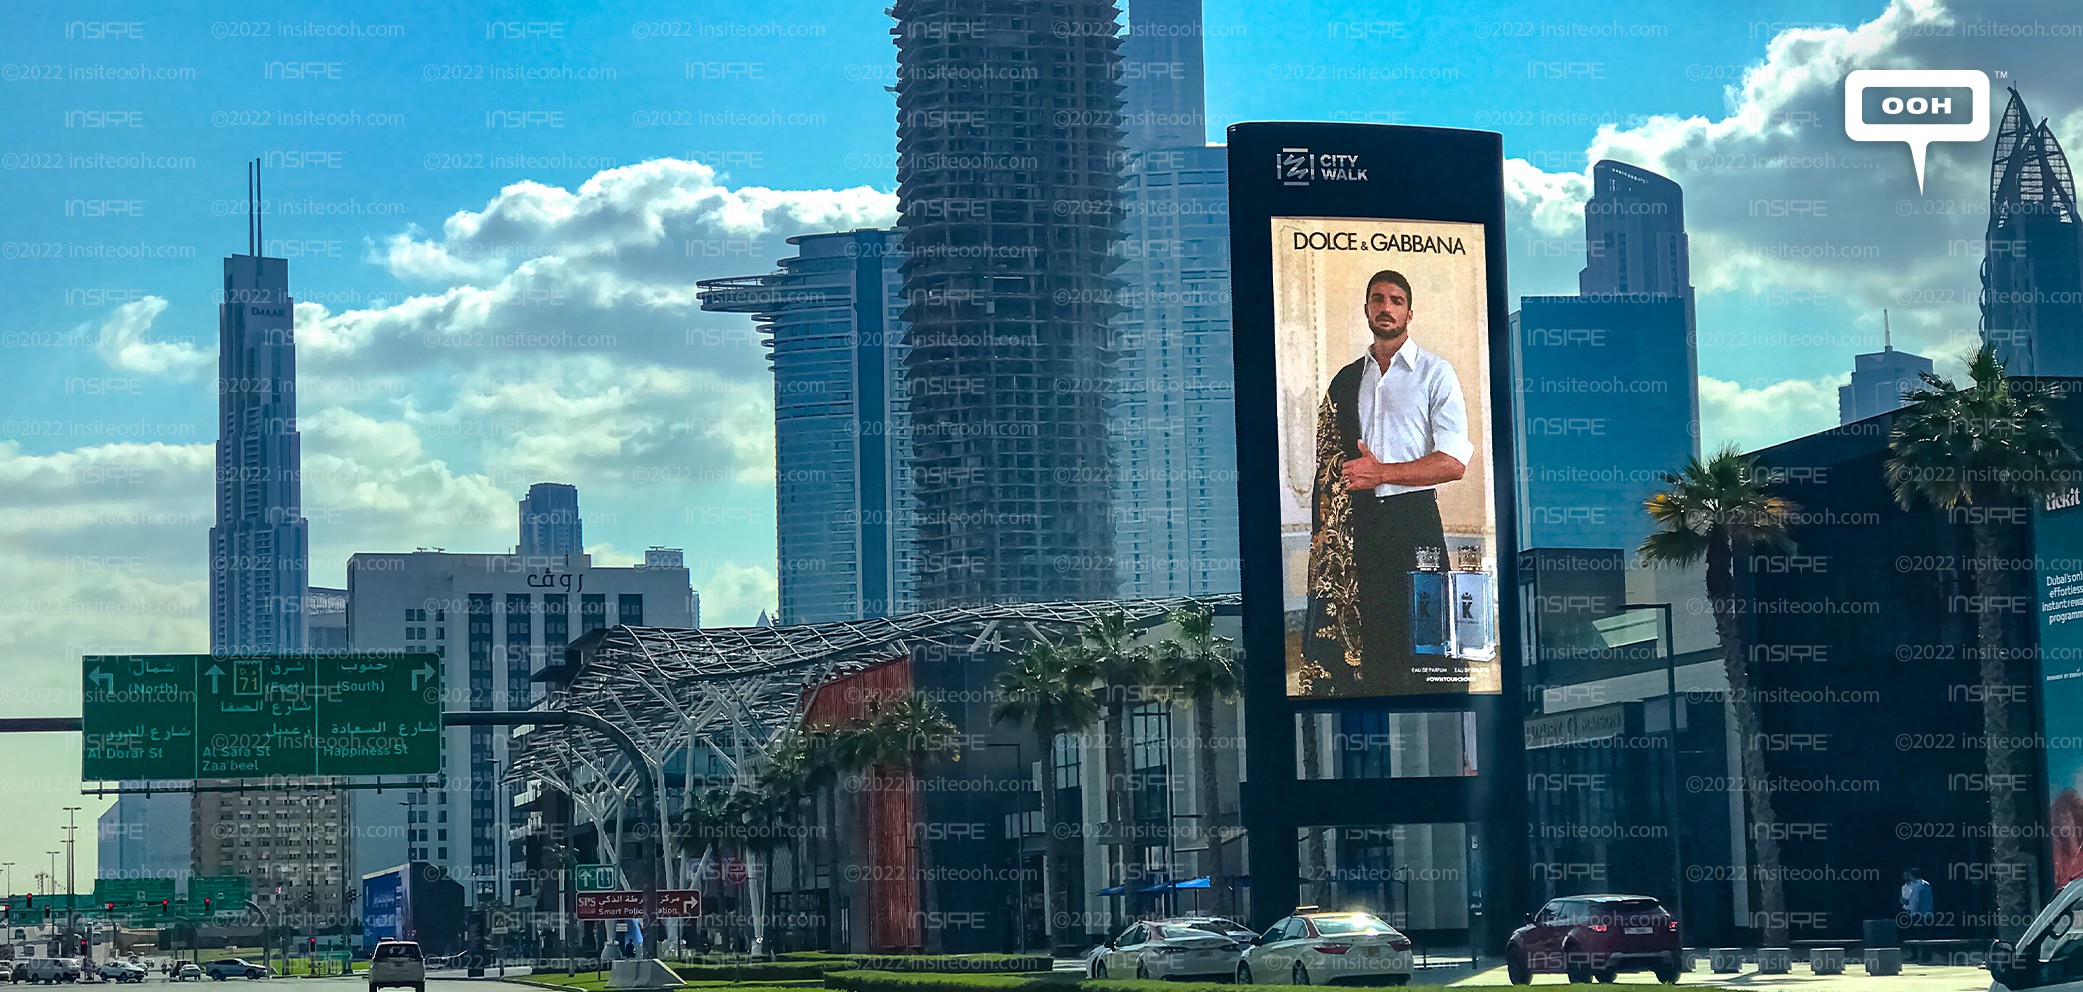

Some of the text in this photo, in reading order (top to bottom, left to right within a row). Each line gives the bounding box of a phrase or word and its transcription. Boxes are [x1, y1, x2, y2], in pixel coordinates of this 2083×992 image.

[1320, 154, 1359, 168] CITY
[1320, 168, 1369, 182] WALK
[1293, 232, 1466, 256] DOLCE & GABBANA
[2041, 597, 2083, 612] instant rewa
[2048, 610, 2083, 626] programm
[129, 683, 178, 695] (North)
[240, 677, 257, 691] 71
[336, 680, 385, 693] (South)
[87, 747, 163, 759] Al Dorar St
[202, 746, 271, 757] Al Safa St
[323, 744, 409, 758] Happiness St
[578, 897, 596, 907] SPS
[598, 906, 678, 916] Smart Polic ation
